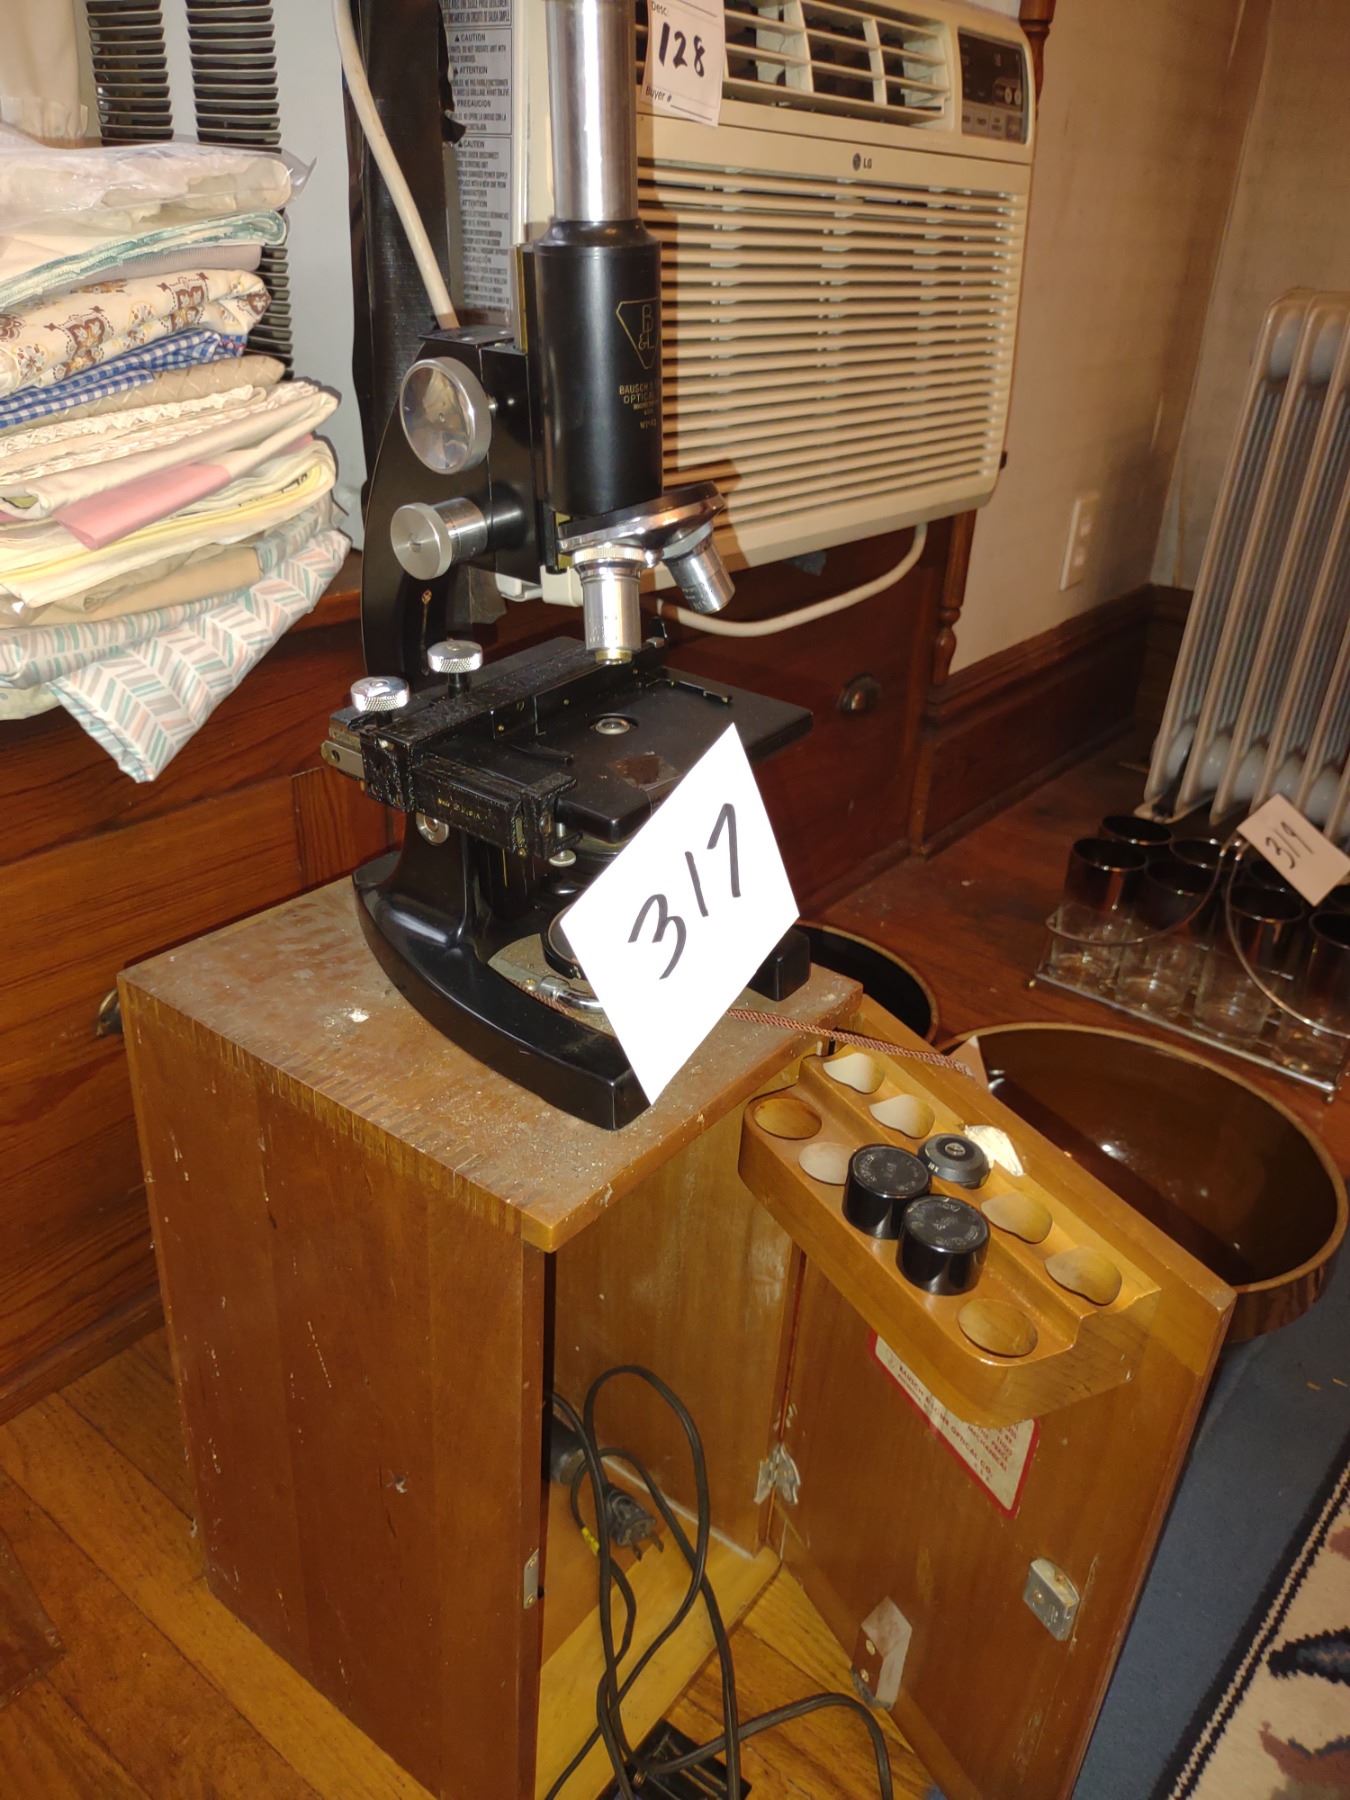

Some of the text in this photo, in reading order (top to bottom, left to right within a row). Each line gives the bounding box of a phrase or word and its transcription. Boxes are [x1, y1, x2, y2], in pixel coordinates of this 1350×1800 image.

[461, 33, 486, 42] CAUTION
[658, 21, 706, 78] 128
[646, 86, 665, 101] Buyer
[863, 157, 873, 169] LG
[619, 383, 649, 396] BAUSCH
[1265, 821, 1315, 870] 319
[627, 802, 742, 981] 317
